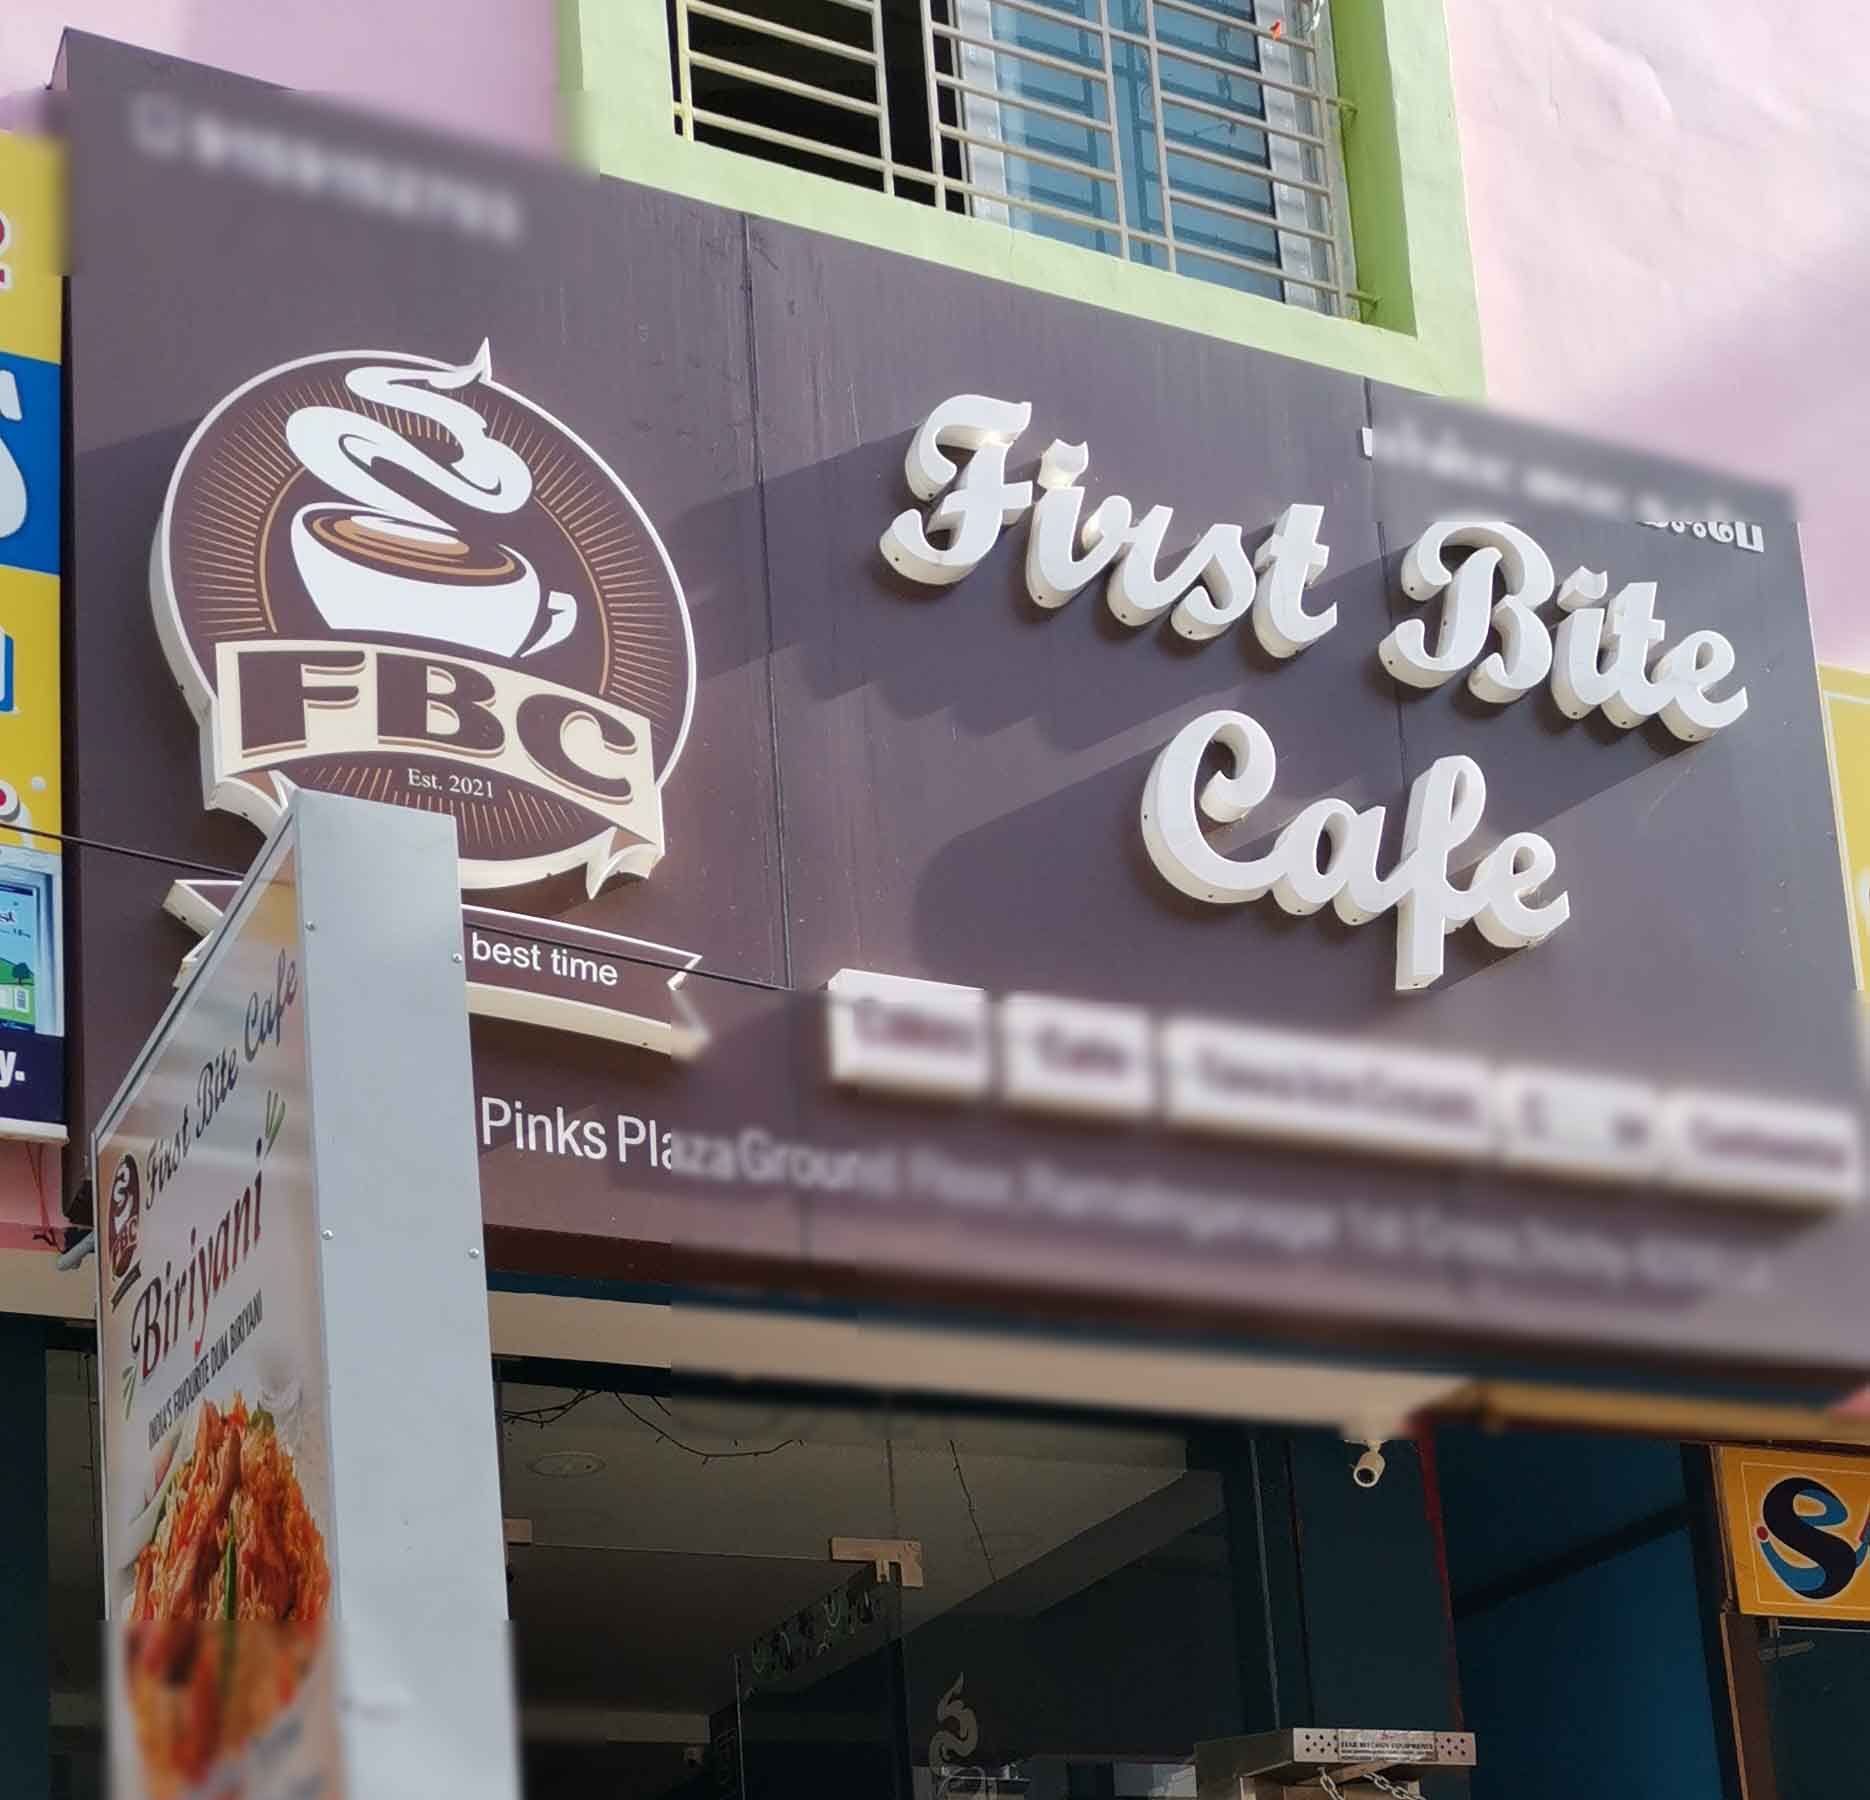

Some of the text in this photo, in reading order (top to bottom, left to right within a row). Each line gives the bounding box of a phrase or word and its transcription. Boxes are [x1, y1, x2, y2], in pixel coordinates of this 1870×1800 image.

[879, 394, 1337, 658] First
[1379, 519, 1749, 742] Bite
[237, 650, 638, 805] FBC
[408, 767, 494, 799] Est. 2021
[1141, 710, 1569, 990] Cafe
[472, 932, 619, 986] best time
[146, 948, 298, 1211] First Bite Cafe
[481, 1096, 608, 1160] Pinks
[131, 1137, 263, 1379] Biriyani
